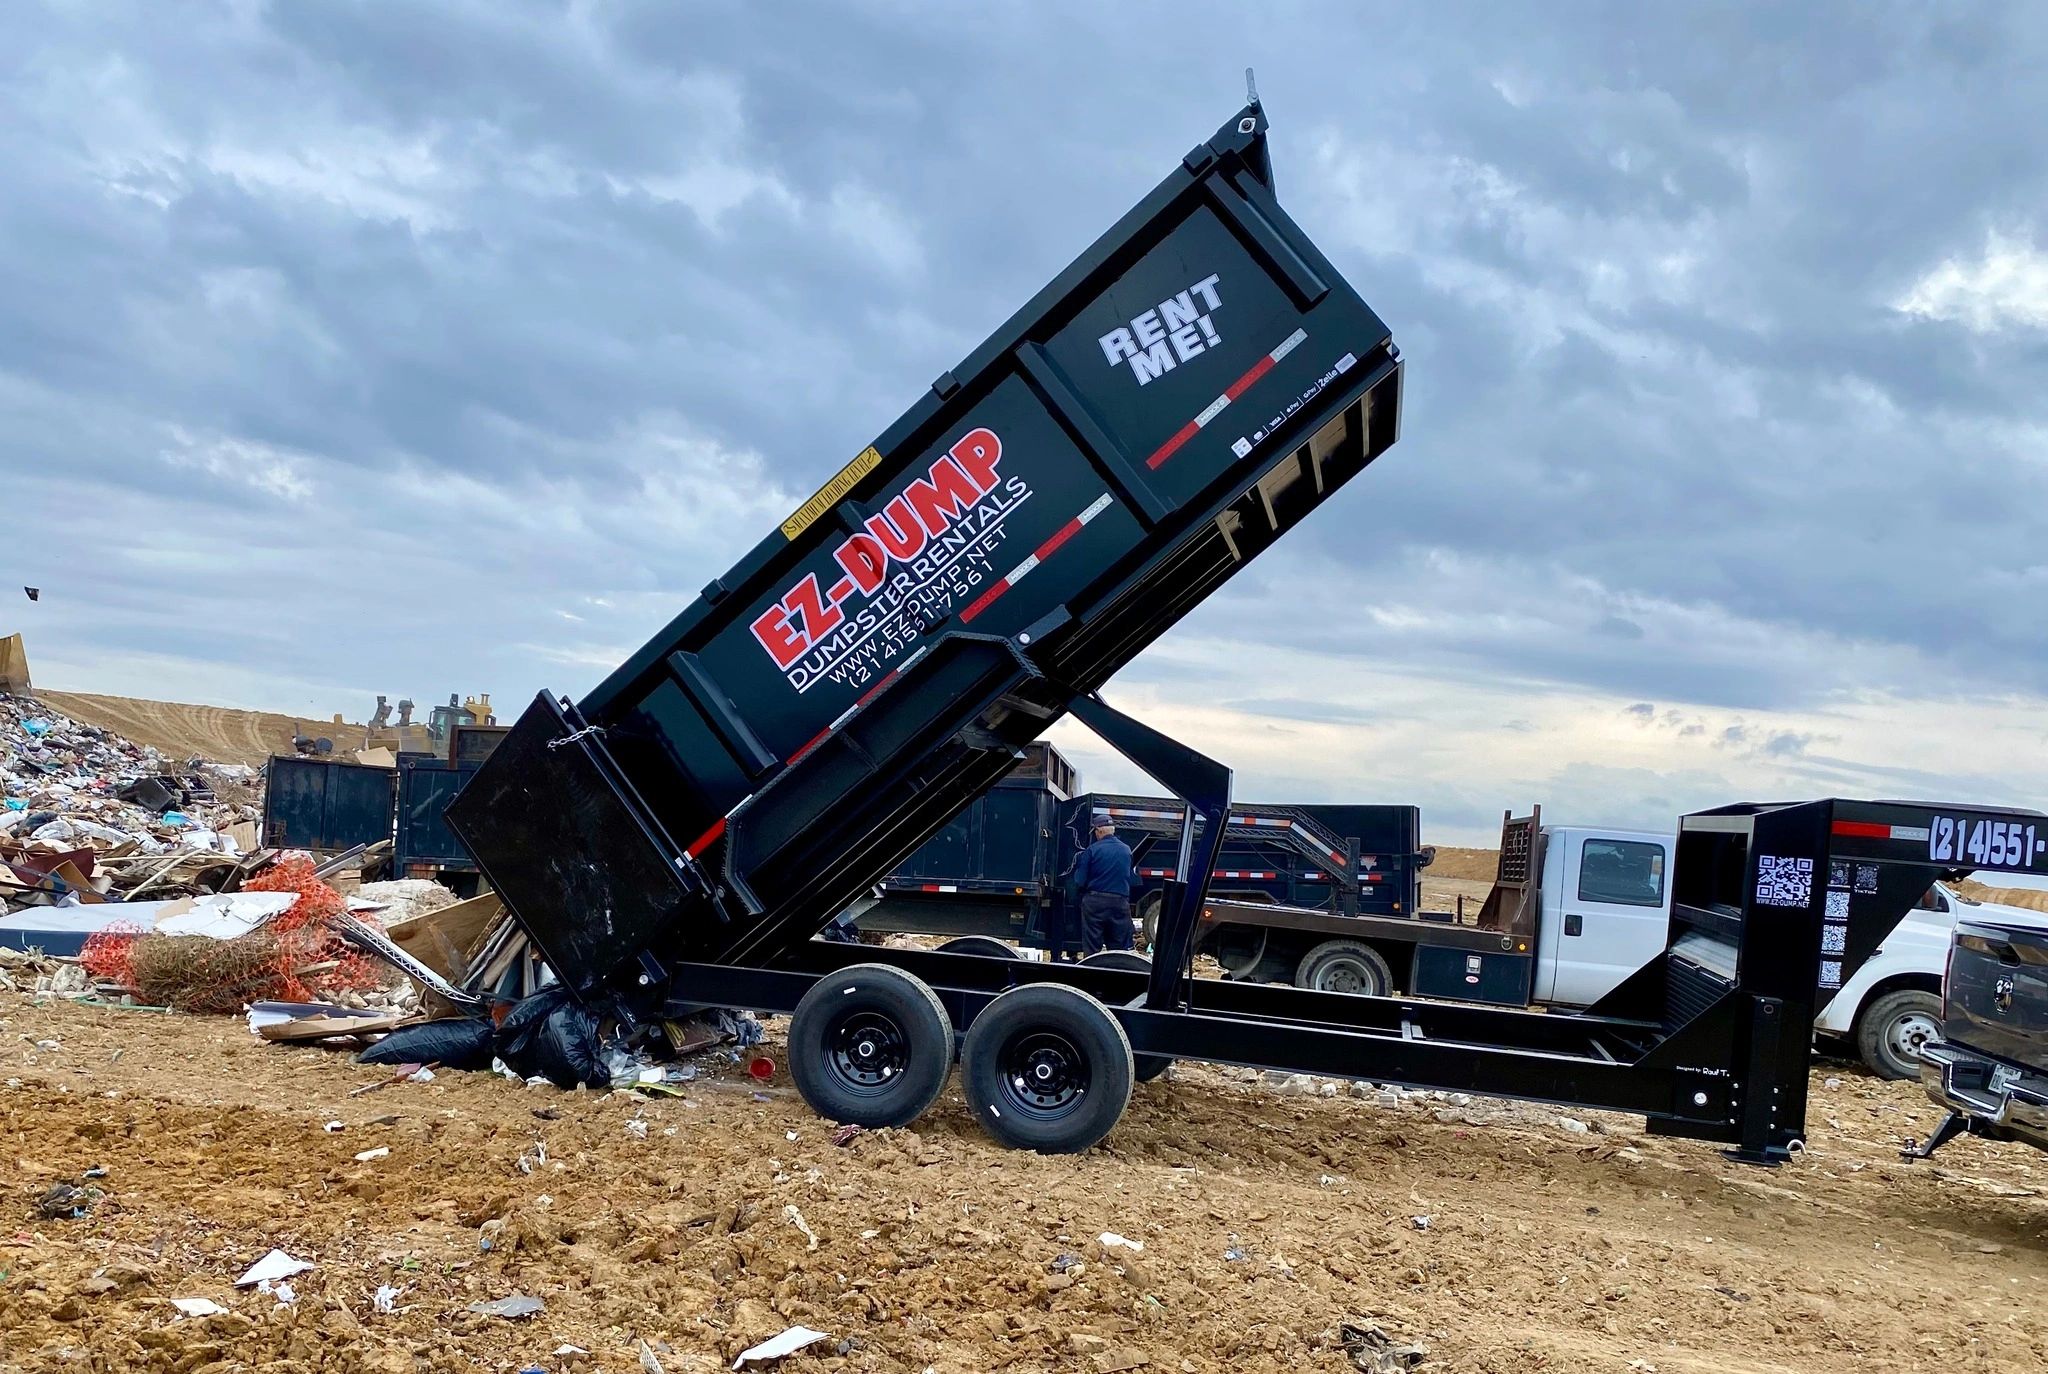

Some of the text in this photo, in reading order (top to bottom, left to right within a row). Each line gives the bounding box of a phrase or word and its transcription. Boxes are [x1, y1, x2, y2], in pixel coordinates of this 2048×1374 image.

[1098, 273, 1223, 366] RENT
[1127, 313, 1222, 386] ME!
[1318, 369, 1338, 388] Zelle
[750, 427, 1002, 671] EZ-DUMP
[787, 475, 1027, 690] DUMPSTER RENTALS
[828, 523, 1007, 684] WWW.EZ-DUMP.NET
[1929, 815, 2046, 867] (214)551-
